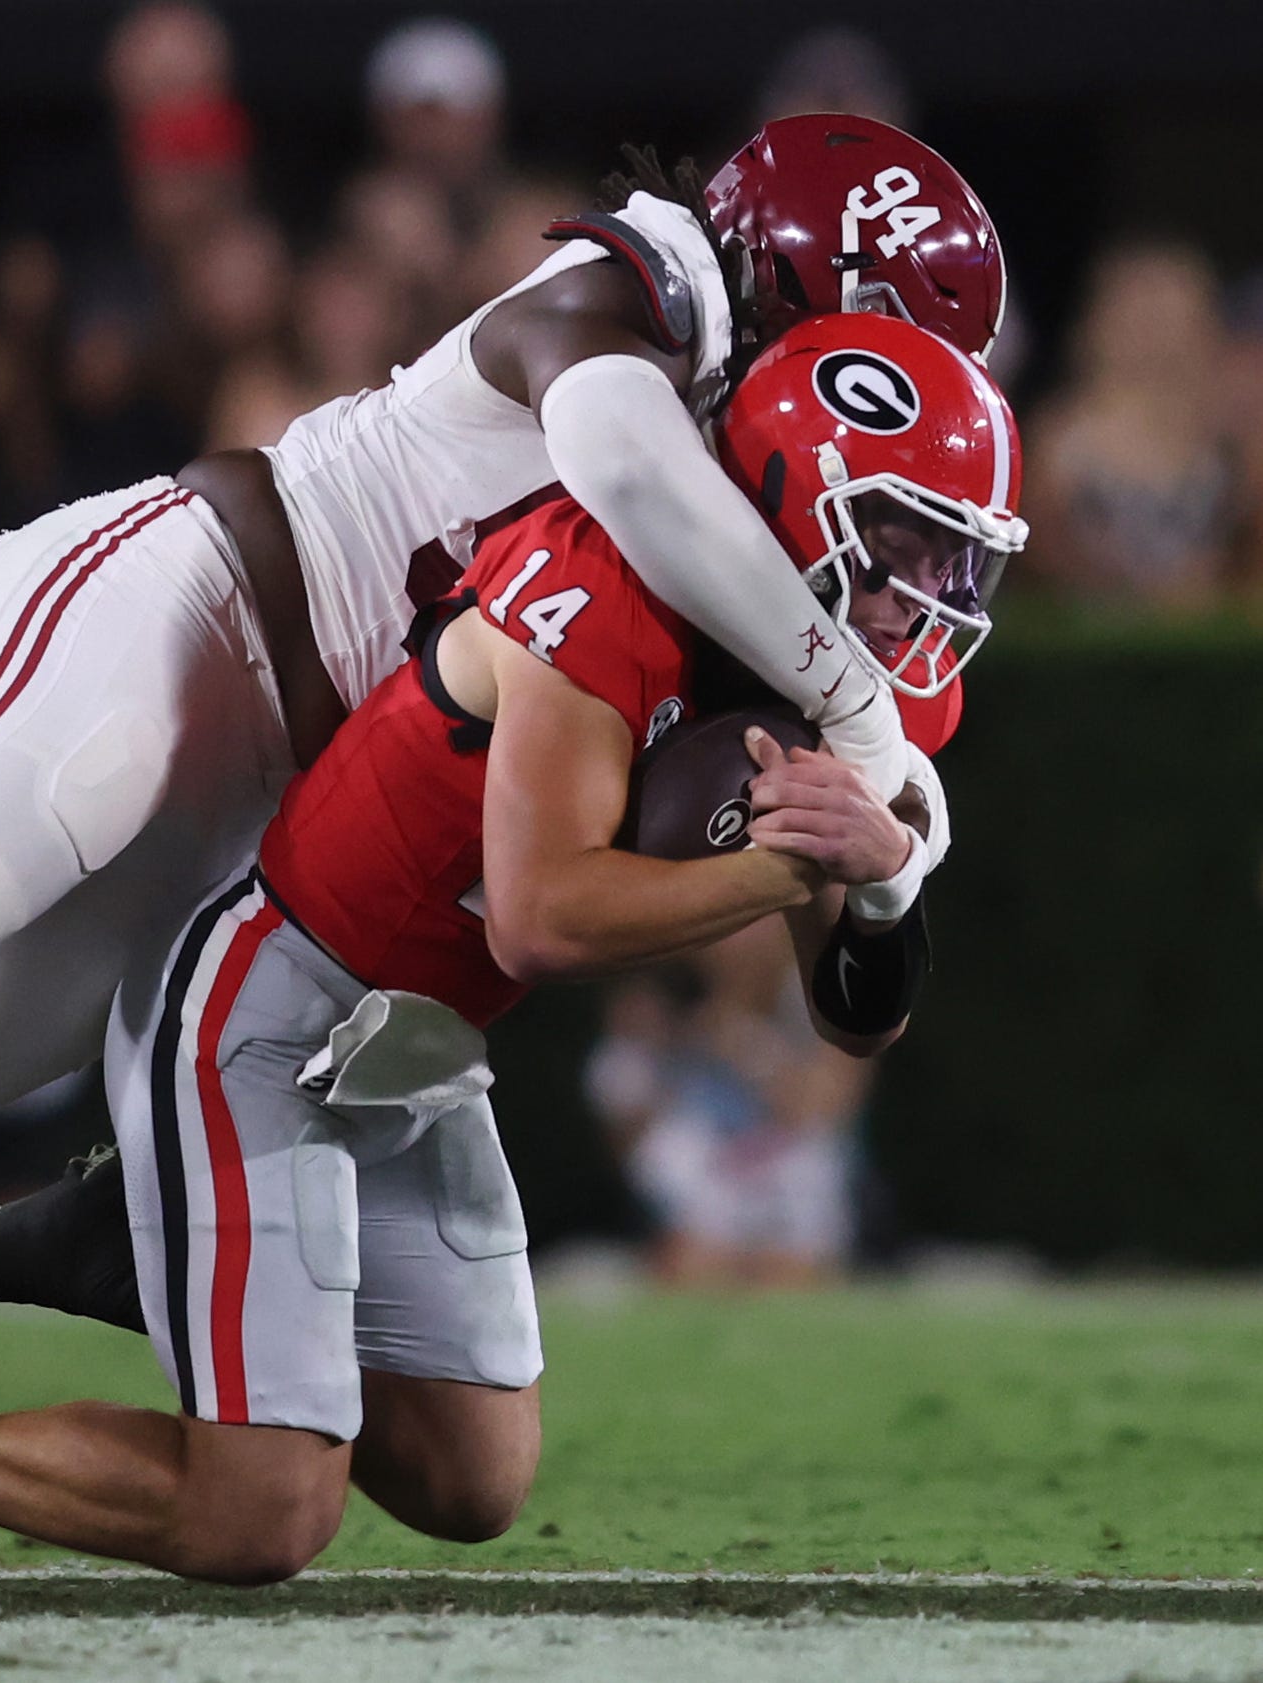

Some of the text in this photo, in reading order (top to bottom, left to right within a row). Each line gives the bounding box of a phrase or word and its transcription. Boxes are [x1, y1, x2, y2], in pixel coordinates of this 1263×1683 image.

[848, 166, 941, 259] 94
[812, 348, 921, 436] G
[489, 548, 591, 664] 14
